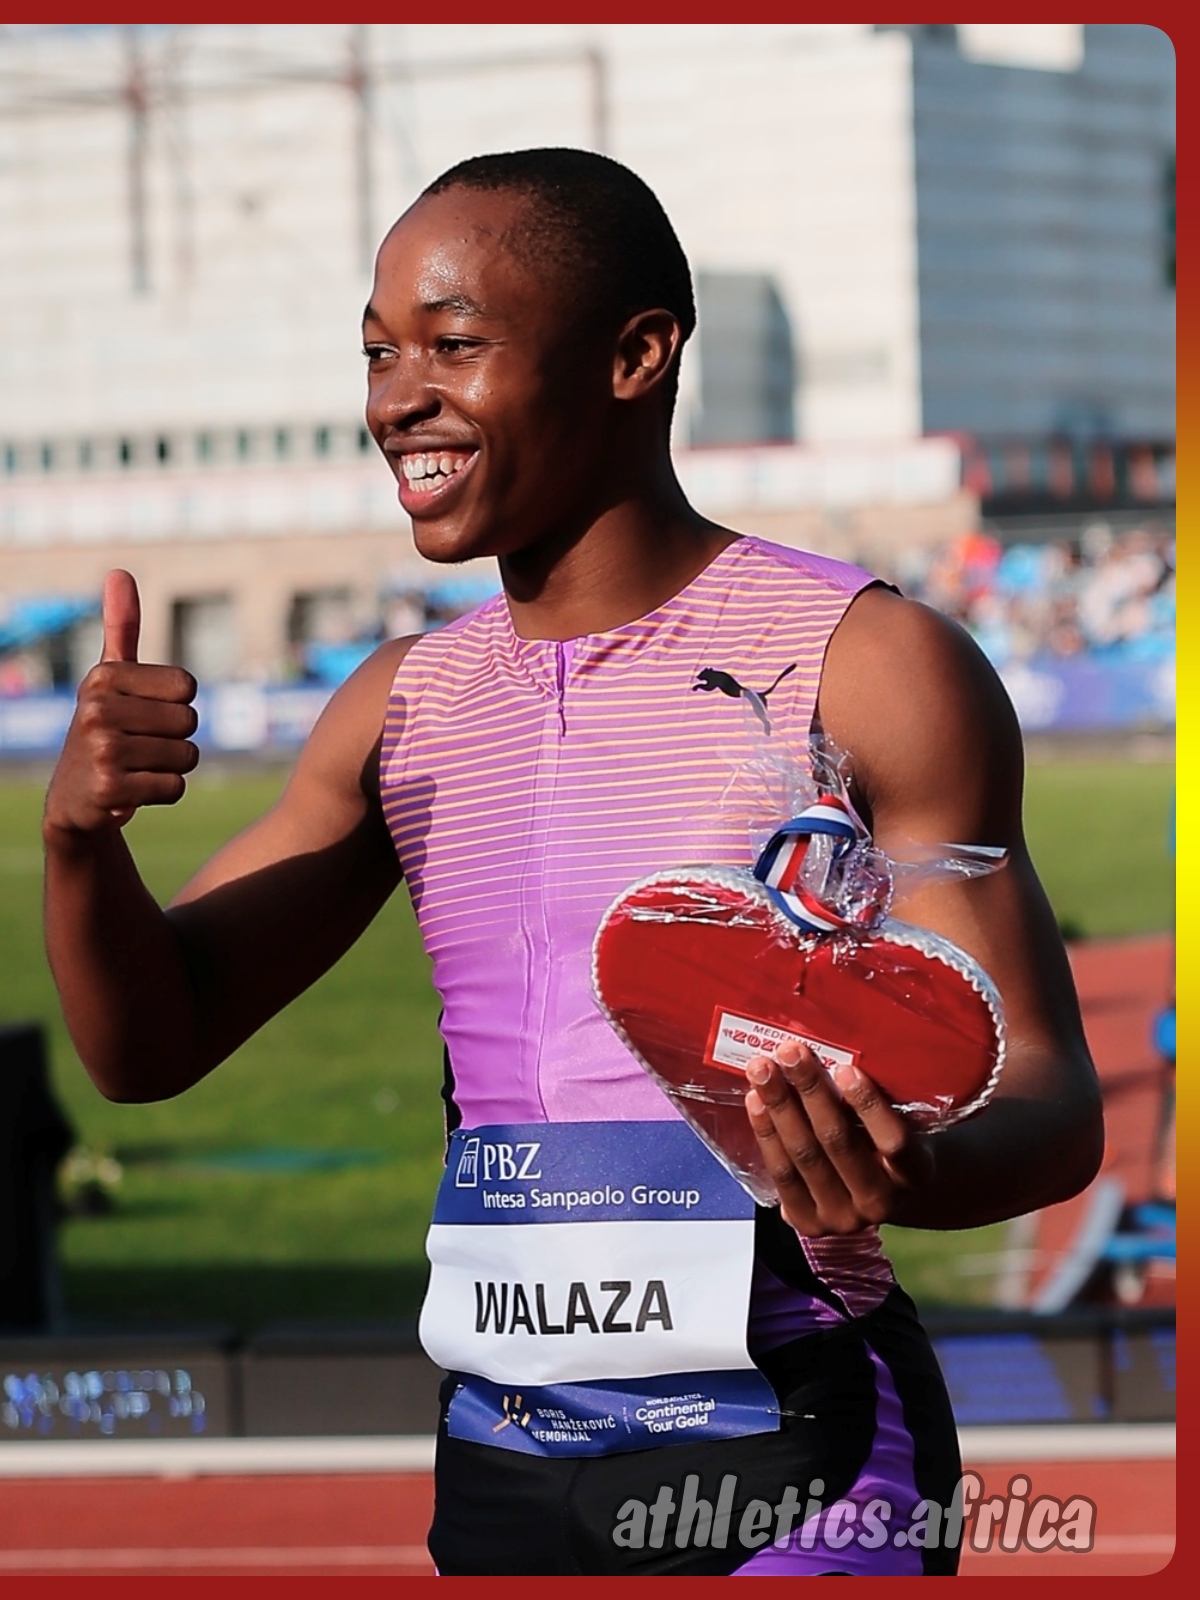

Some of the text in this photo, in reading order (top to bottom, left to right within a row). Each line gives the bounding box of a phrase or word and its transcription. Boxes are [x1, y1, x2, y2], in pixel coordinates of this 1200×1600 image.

[753, 1025, 822, 1052] MEDEACI
[482, 1143, 542, 1181] PBZ
[483, 1184, 700, 1210] Intesa Sanpaolo Group
[474, 1280, 674, 1335] WALAZA
[635, 1398, 715, 1421] Continental
[645, 1397, 669, 1406] WORLD
[536, 1408, 567, 1420] BORIS
[550, 1414, 616, 1431] HANŽEKOVIĆ
[643, 1420, 674, 1434] Tour
[675, 1412, 709, 1429] Gold
